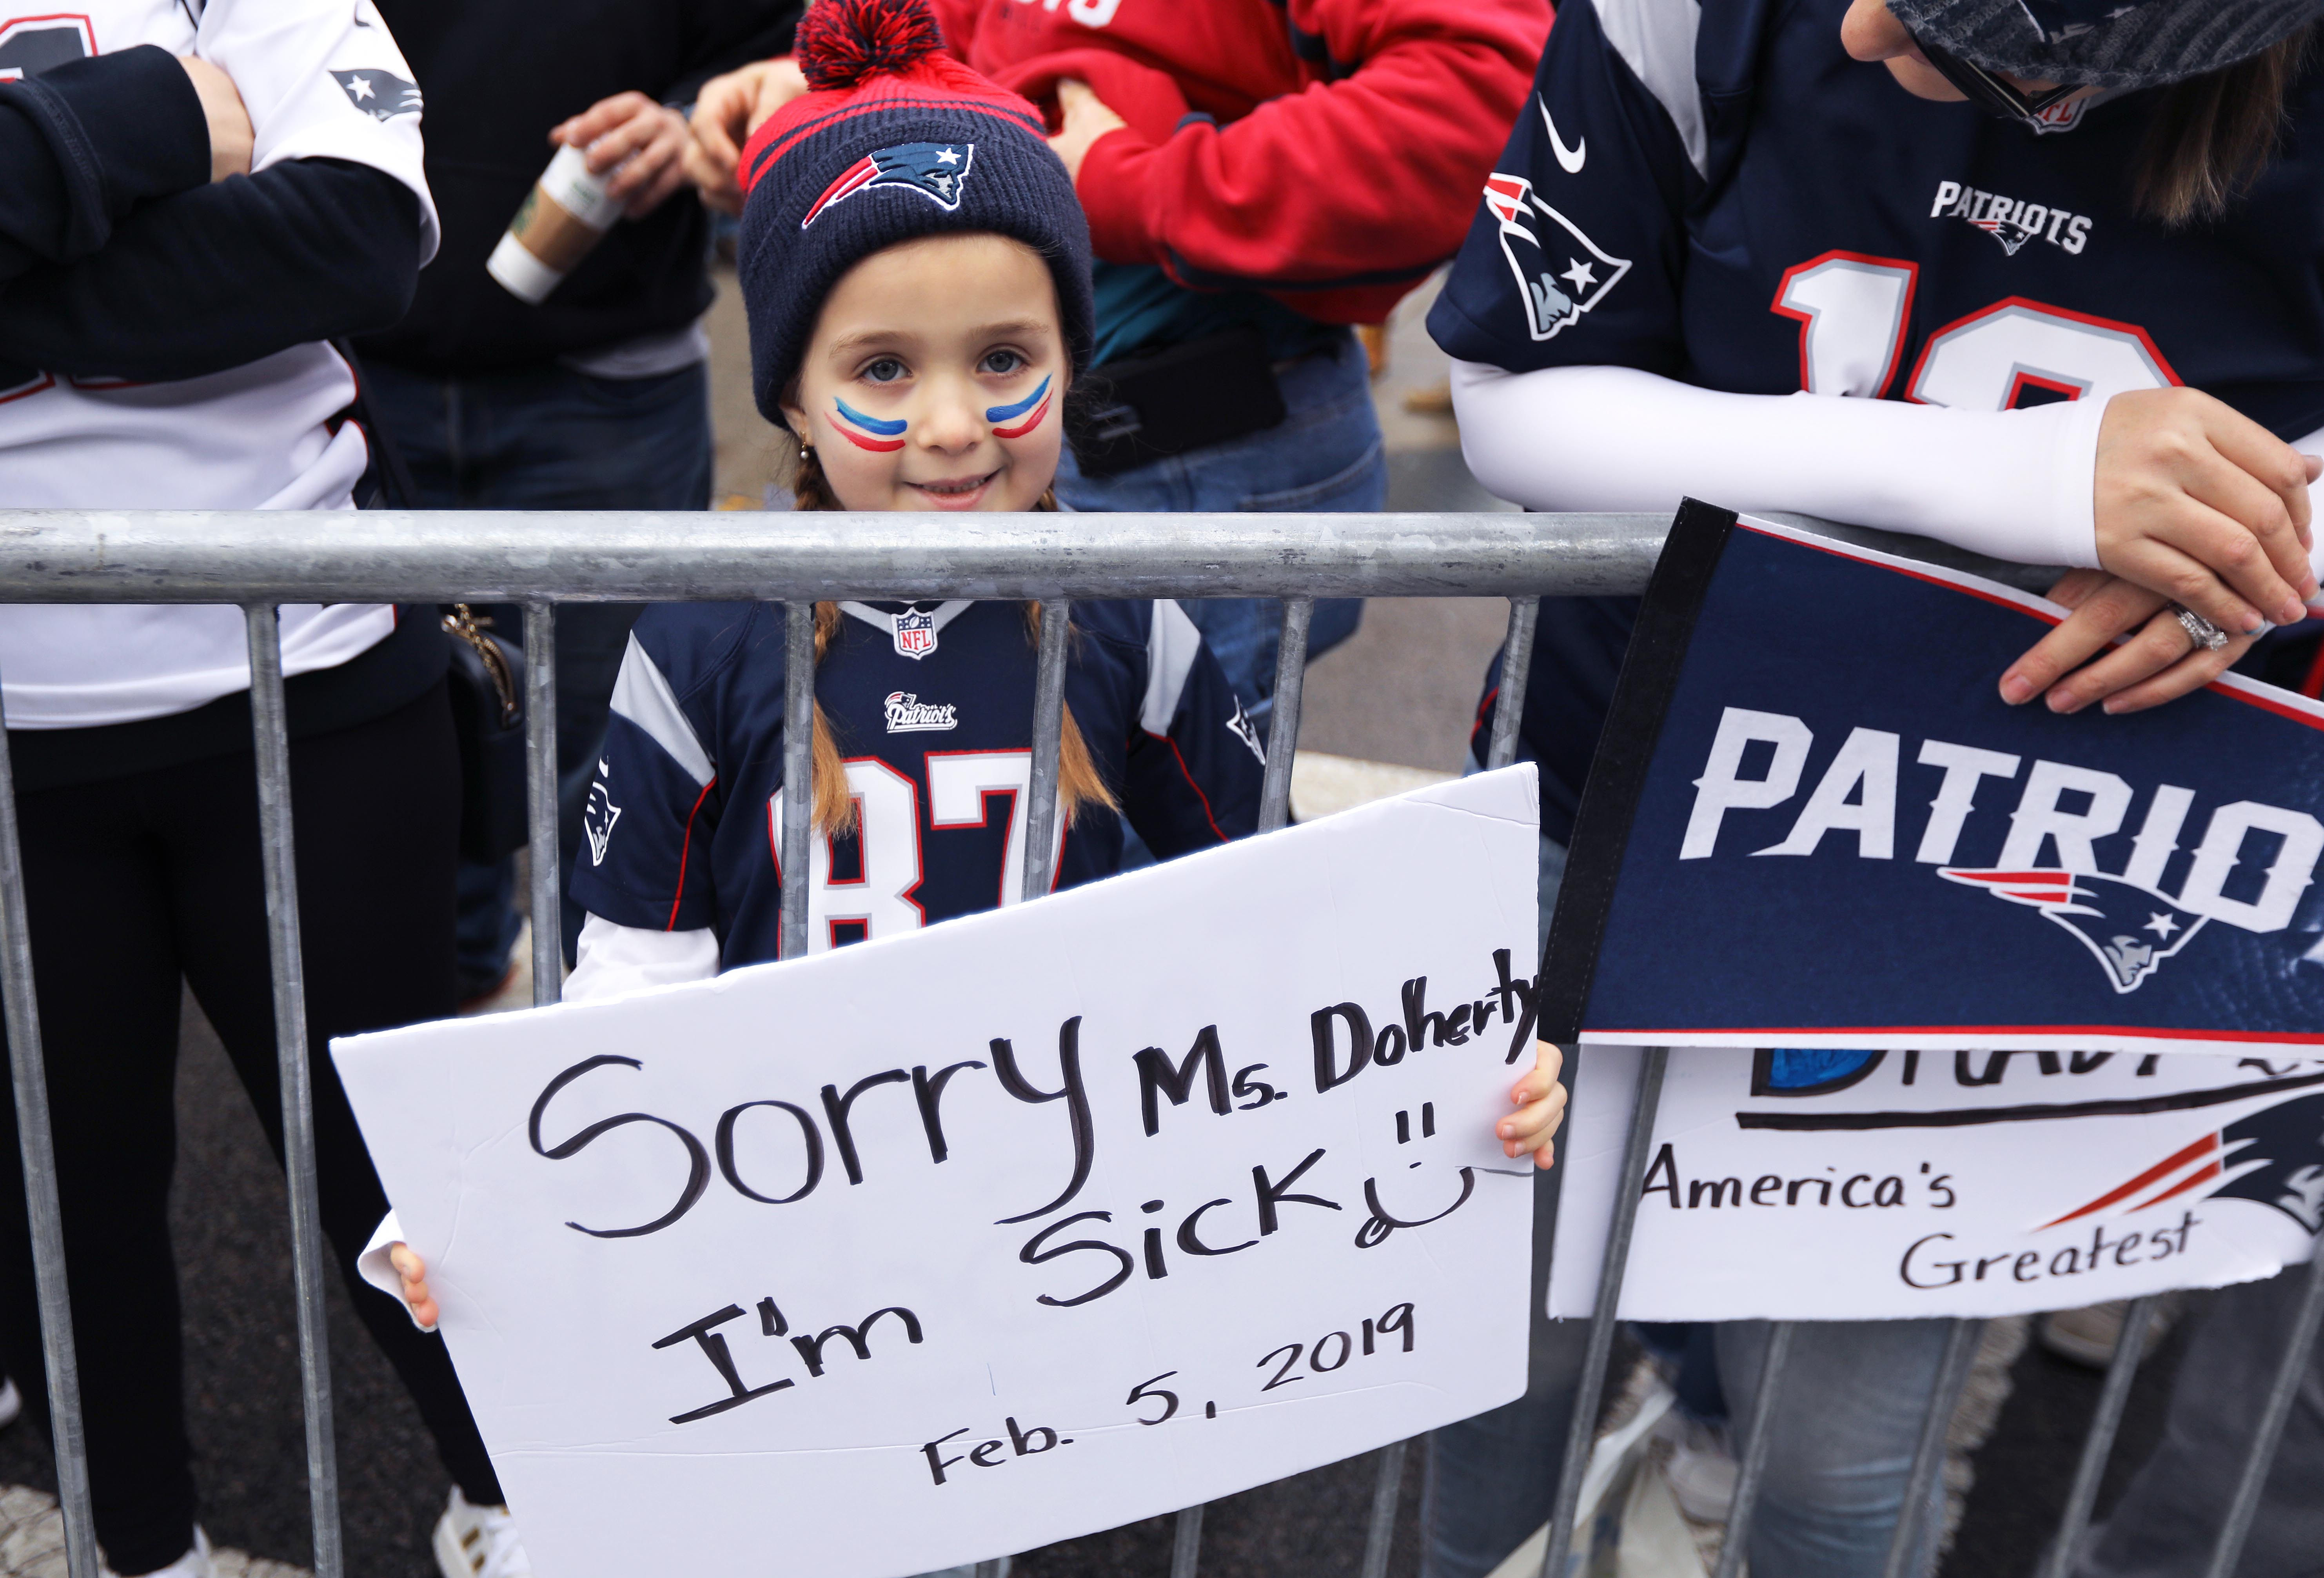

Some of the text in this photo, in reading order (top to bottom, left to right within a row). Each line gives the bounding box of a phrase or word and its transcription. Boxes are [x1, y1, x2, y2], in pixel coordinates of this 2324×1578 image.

[1930, 180, 2093, 255] PATRIOTS
[901, 630, 931, 650] NFL
[885, 703, 957, 731] Patriots
[767, 747, 1069, 961] 87
[529, 948, 1538, 1238] Sorry Ms. Doherty
[1640, 1143, 1956, 1209] America's
[652, 1149, 1342, 1424] I'm Sick
[1900, 1212, 2202, 1289] Greatest
[920, 1303, 1414, 1485] Feb. 5, 2019
